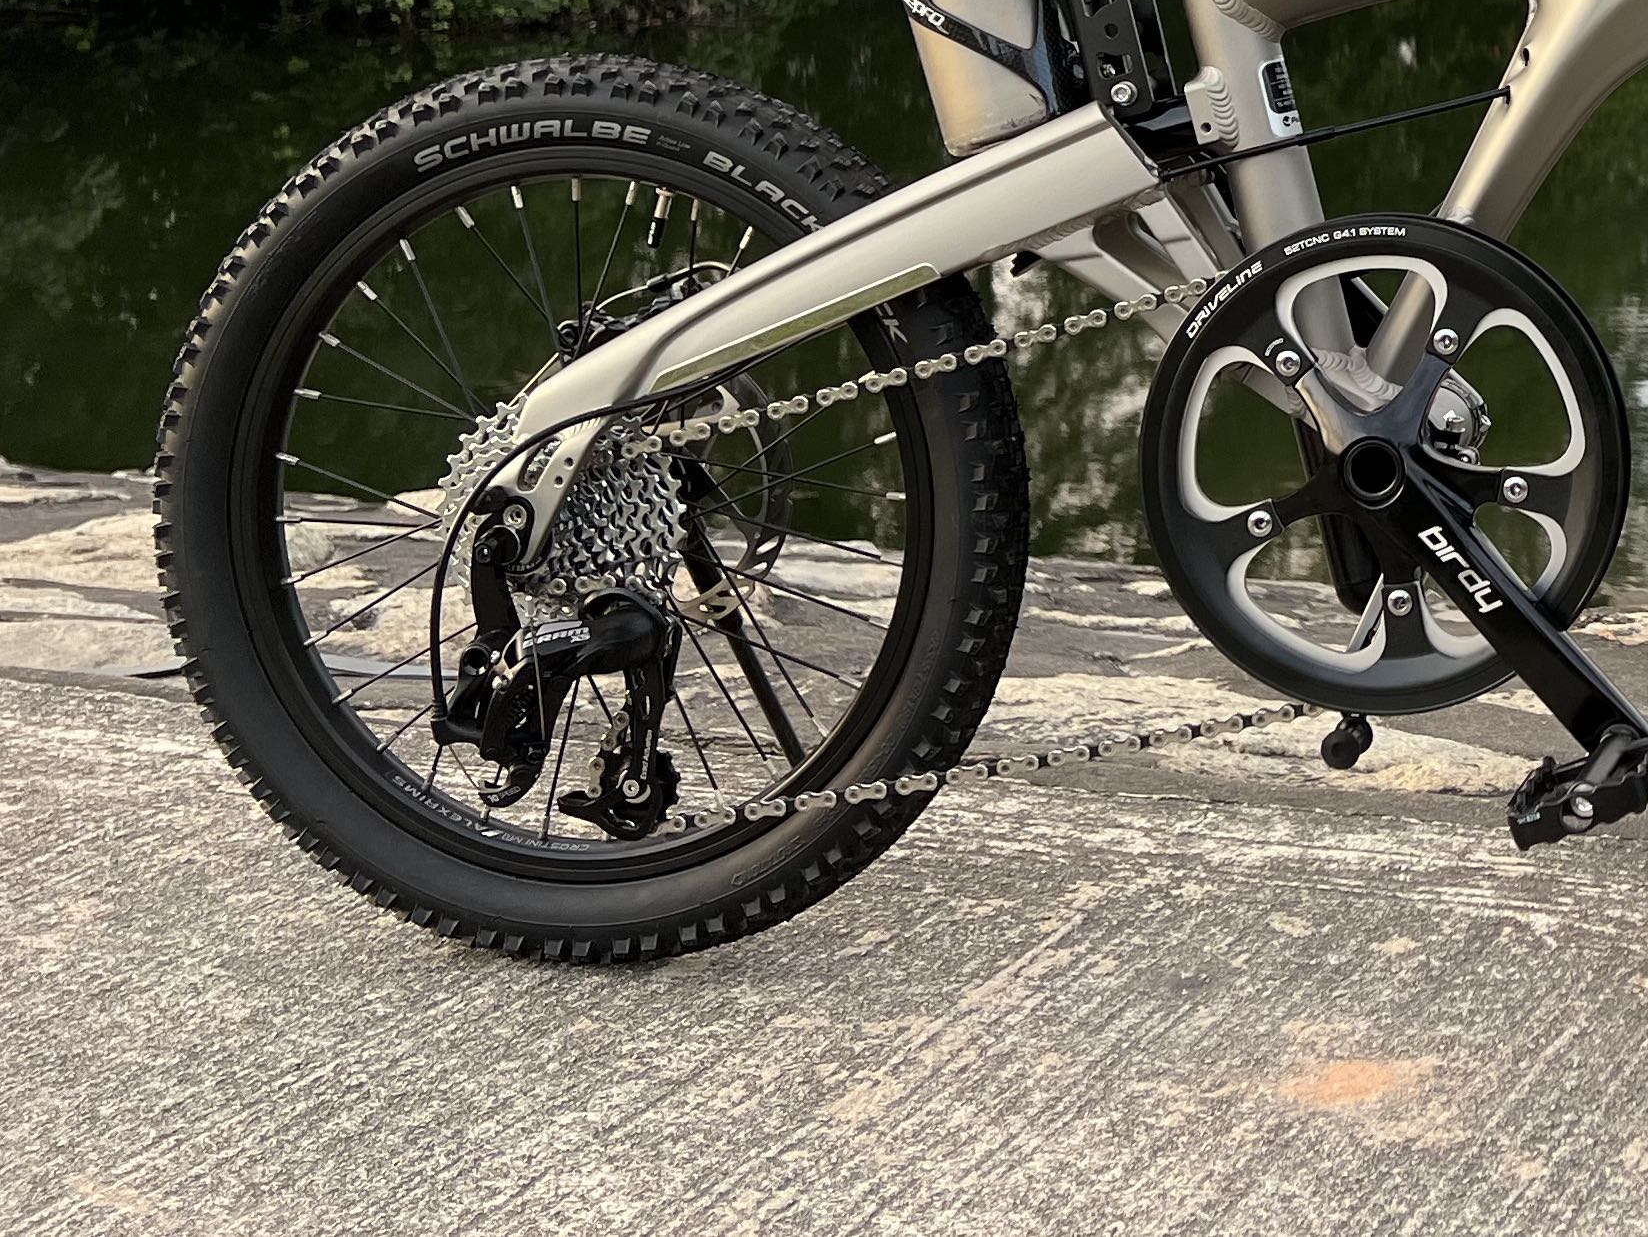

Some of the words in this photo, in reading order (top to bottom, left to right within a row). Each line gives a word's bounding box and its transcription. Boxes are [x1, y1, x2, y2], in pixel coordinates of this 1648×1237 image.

[413, 118, 653, 173] SCHWALBE
[702, 150, 827, 235] BLACK
[1359, 226, 1406, 237] SYSTEM
[1186, 260, 1263, 339] DRIVELINE
[1417, 525, 1504, 614] birdy
